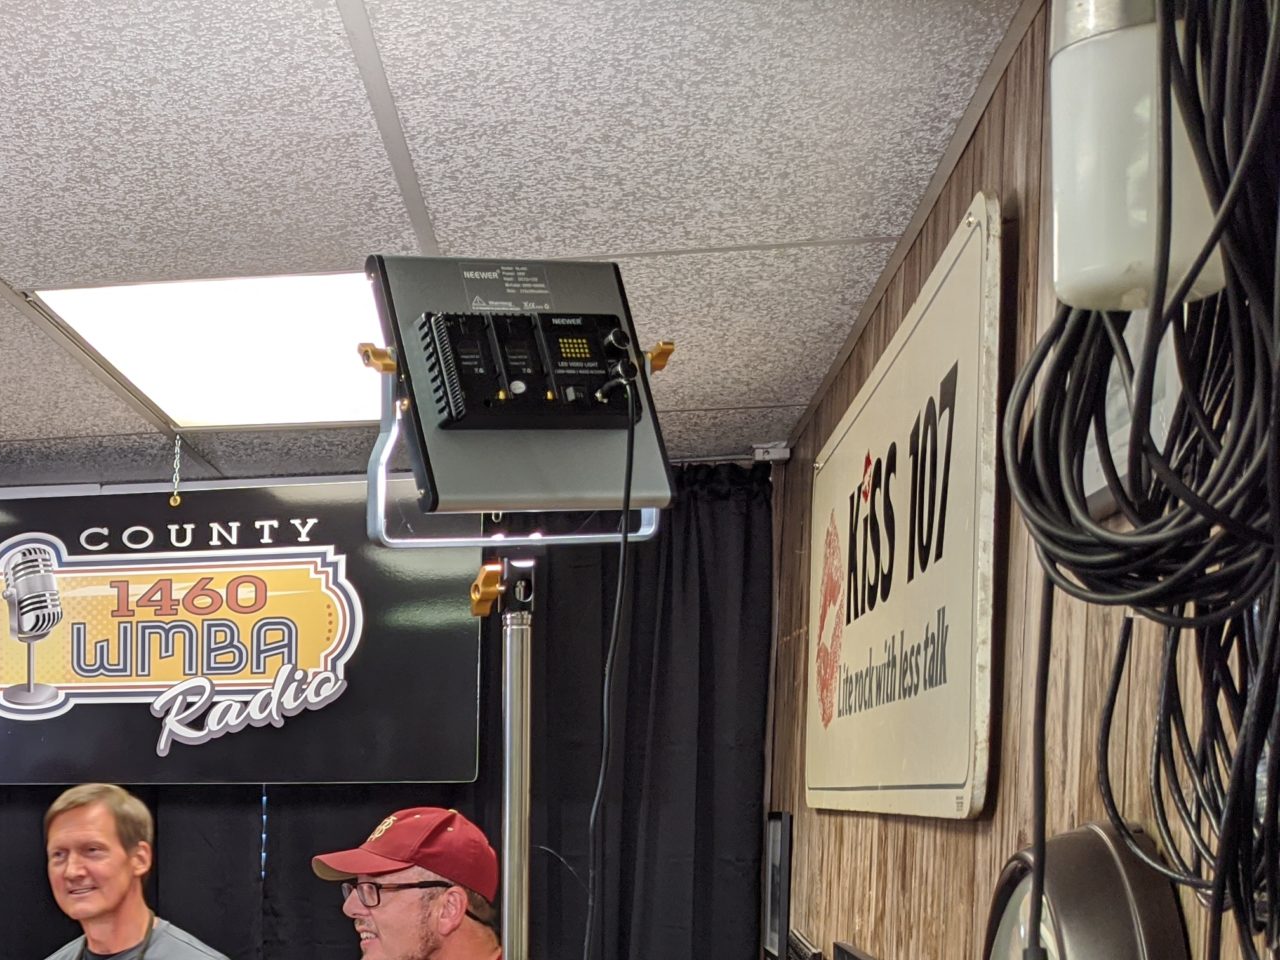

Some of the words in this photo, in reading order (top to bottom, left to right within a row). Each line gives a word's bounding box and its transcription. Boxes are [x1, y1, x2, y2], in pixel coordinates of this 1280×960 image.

[463, 271, 499, 279] NEEWER
[906, 359, 959, 585] 107
[79, 518, 319, 551] COUNTY
[109, 574, 268, 618] 1460
[71, 616, 299, 678] WMBA
[837, 662, 853, 718] Lite
[854, 647, 875, 714] rock
[875, 634, 897, 707] with
[898, 629, 921, 700] less
[923, 605, 949, 691] talk
[151, 663, 345, 755] Radio
